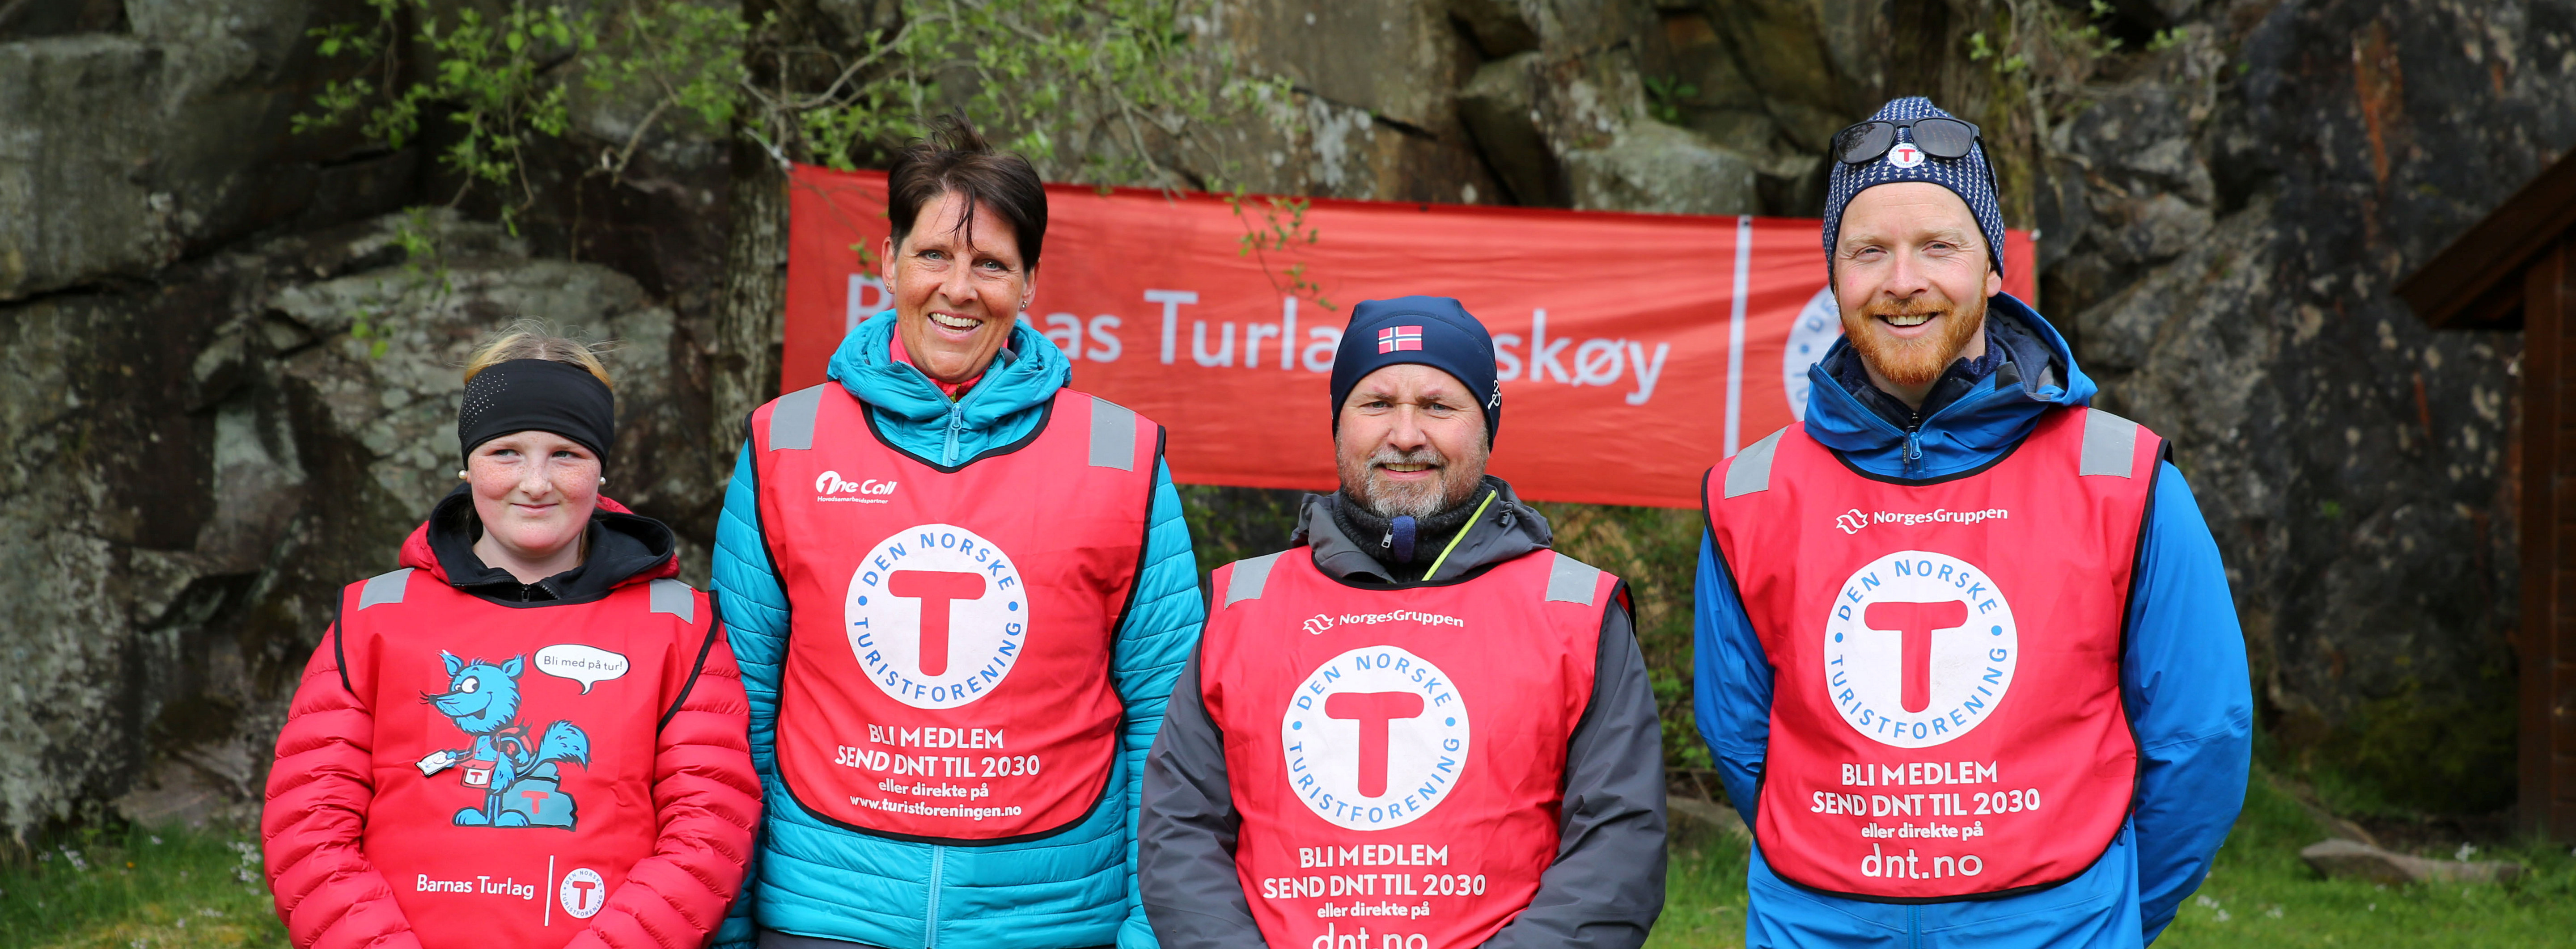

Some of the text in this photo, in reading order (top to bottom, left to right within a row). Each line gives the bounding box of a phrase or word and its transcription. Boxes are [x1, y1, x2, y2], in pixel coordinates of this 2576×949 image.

[1898, 149, 1916, 162] T
[845, 274, 1670, 406] Bas Turla skøy
[817, 496, 889, 504] Hovedsamarbeidspartner
[860, 479, 898, 495] Call
[1874, 508, 2008, 526] NorgesGruppen
[862, 532, 1015, 590] DEN NORSKE
[1838, 559, 1998, 621] DEN NORSKE
[888, 570, 986, 676] T
[1339, 609, 1464, 628] NorgesGruppen
[544, 655, 622, 671] Bli med på tur!
[854, 617, 1021, 702] TURISTFORENING
[1864, 599, 1968, 713] T
[1296, 653, 1452, 710] DEN NORSKE
[1831, 648, 2007, 739] TURISTFORENING
[868, 724, 1004, 749] BLI MEDLEM
[1325, 691, 1424, 798] T
[835, 745, 1040, 777] SEND DNT TIL 2030
[1842, 760, 1997, 786] BLI MEDLEM
[878, 778, 989, 801] eller direkte på
[1289, 738, 1460, 823] TURISTFORENING
[521, 790, 549, 814] T
[850, 793, 1022, 821] www.turistforeningen.no
[1810, 788, 2040, 817] SEND DNT TIL 2030
[1861, 820, 1983, 841] eller direkte på
[1299, 844, 1448, 868] BLI MEDLEM
[1861, 843, 1983, 879] dnt.no
[416, 874, 534, 900] Barnas Turlag
[565, 870, 602, 887] DEN NORSKE
[1263, 873, 1486, 899] SEND DNT TIL 2030
[562, 892, 603, 916] TURISTFORENING
[572, 881, 596, 910] T
[1317, 901, 1430, 920] eller direkte på
[1312, 922, 1428, 949] dntno
